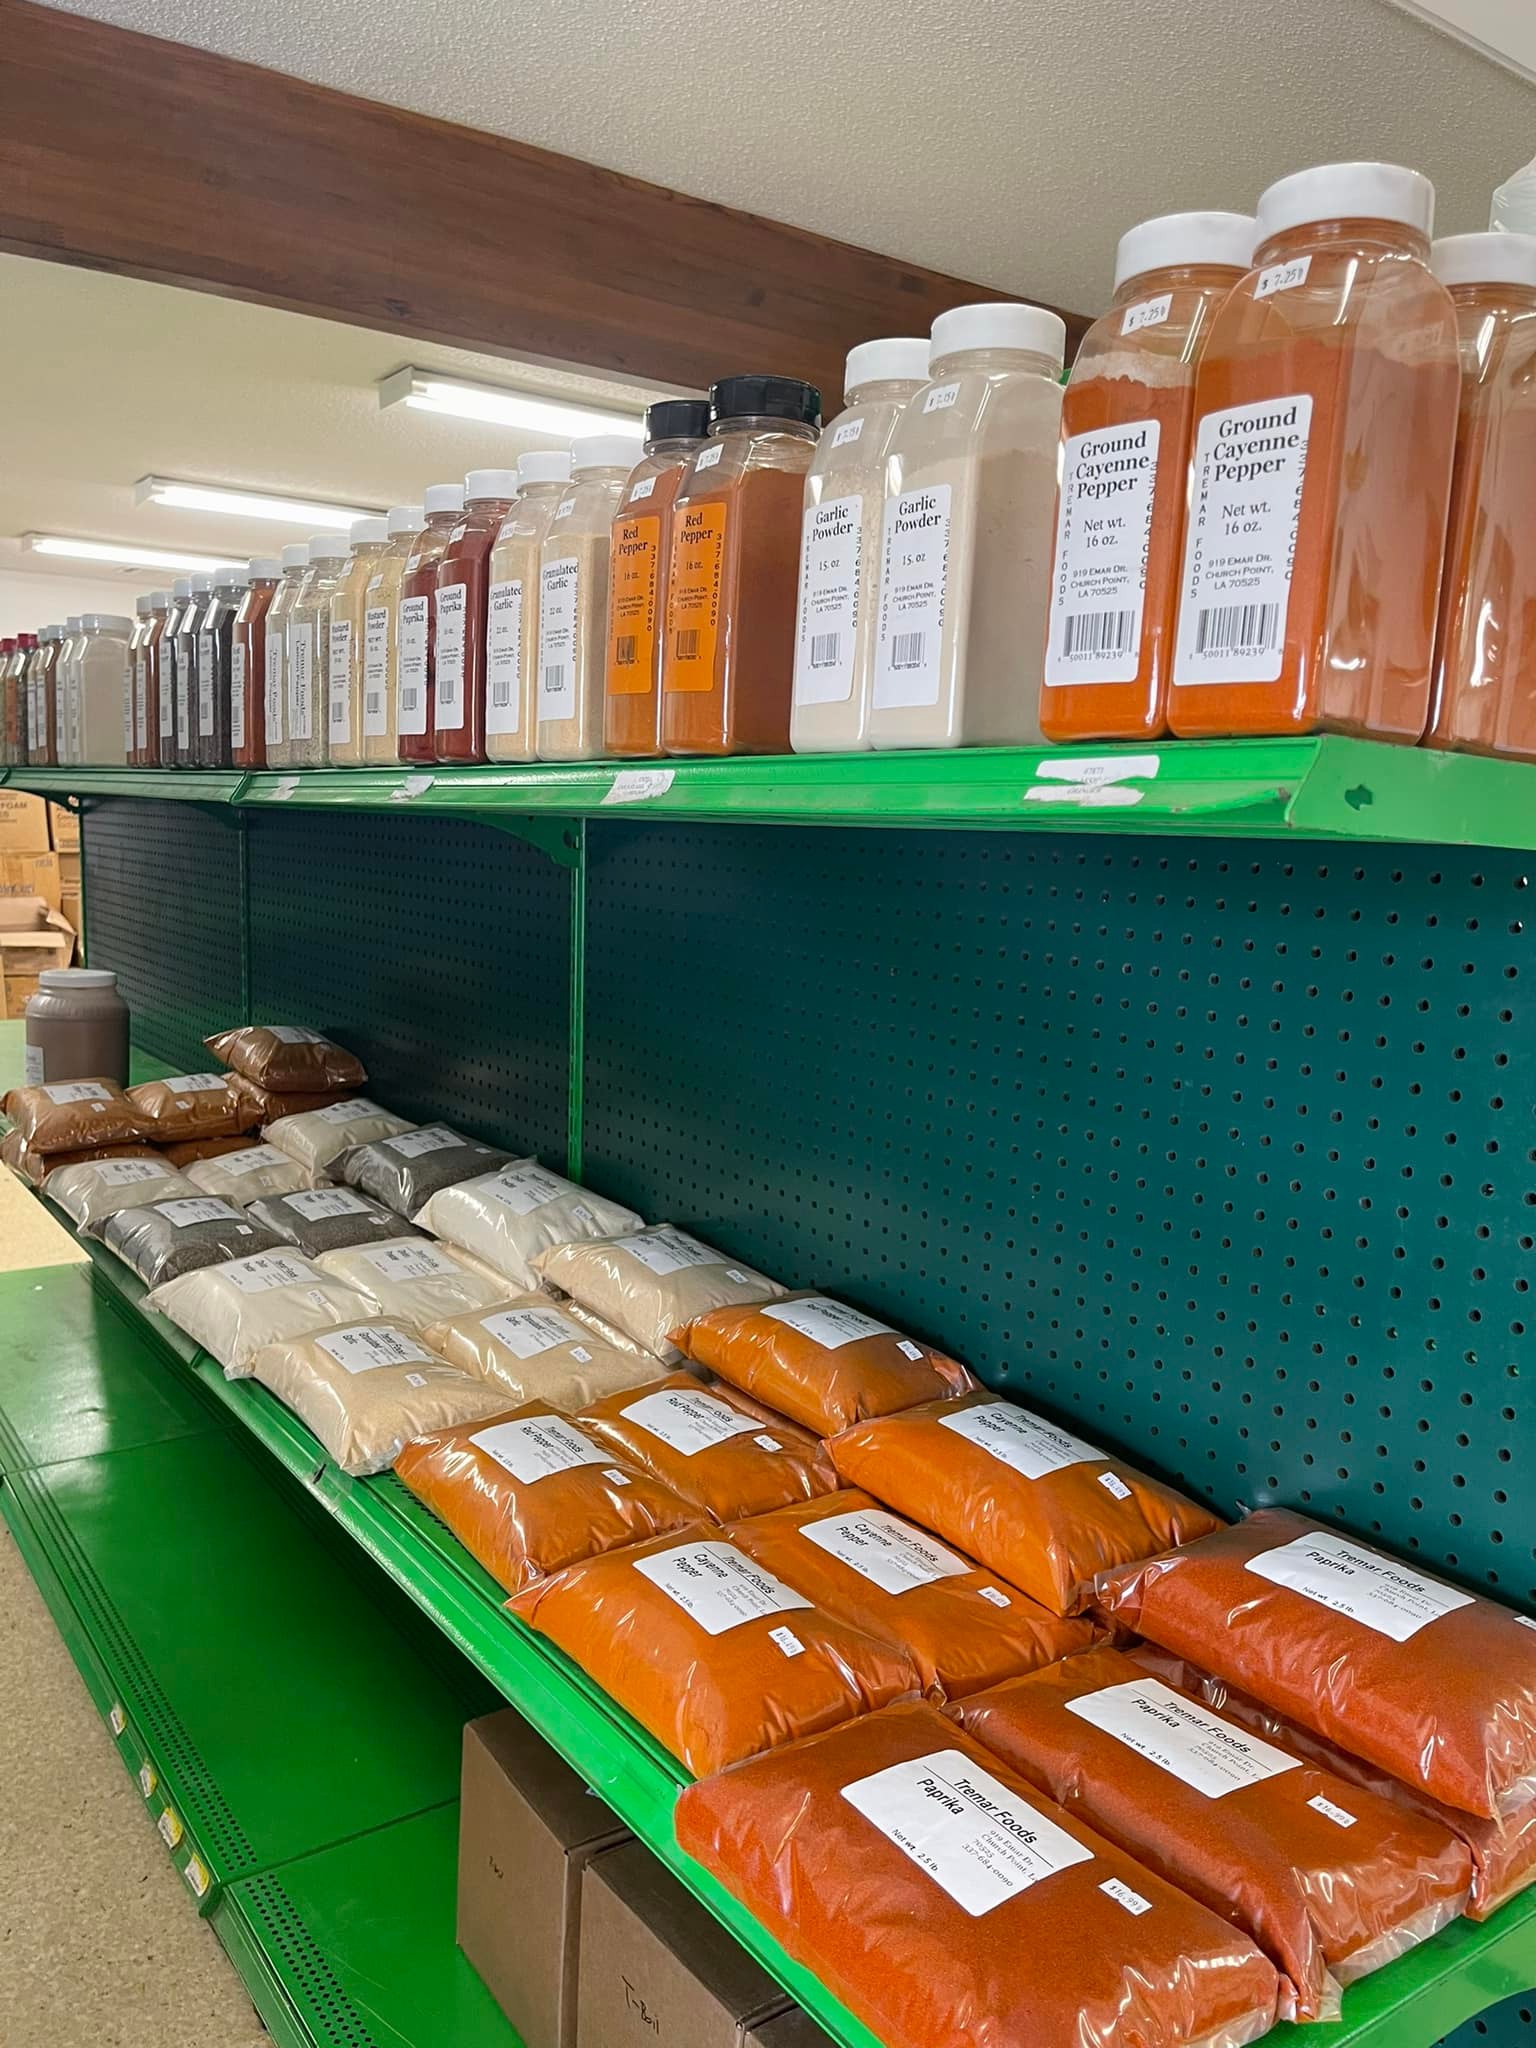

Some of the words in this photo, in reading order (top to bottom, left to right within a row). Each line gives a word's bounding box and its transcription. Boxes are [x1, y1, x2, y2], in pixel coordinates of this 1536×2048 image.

[1219, 406, 1297, 438] Ground
[1080, 430, 1147, 458] Ground
[1213, 433, 1299, 461] Cayenne
[1076, 455, 1150, 480] Cayenne
[1214, 457, 1286, 482] Pepper
[1076, 477, 1138, 499] Pepper
[816, 505, 849, 525] Garlic
[899, 495, 937, 516] Garlic
[1221, 504, 1245, 519] Net
[1250, 501, 1271, 514] wt.
[685, 511, 703, 528] Red
[894, 513, 942, 534] Powder
[1083, 520, 1103, 533] Net
[1107, 517, 1126, 528] wt.
[1225, 521, 1239, 536] 16
[1243, 521, 1262, 533] oz.
[623, 526, 639, 540] Red
[680, 529, 713, 544] Pepper
[812, 521, 854, 542] Powder
[1086, 535, 1098, 549] 16
[1101, 535, 1119, 545] oz.
[618, 542, 648, 557] Pepper
[1073, 569, 1087, 578] 919
[1208, 558, 1226, 568] 919
[547, 577, 569, 591] Garlic
[1078, 590, 1089, 598] LA
[1091, 586, 1118, 596] 70525
[1214, 581, 1226, 590] LA
[1229, 577, 1261, 589] 70525
[494, 598, 513, 611] Garlic
[666, 1396, 681, 1408] Red
[678, 1403, 705, 1420] Pepper
[973, 1415, 1006, 1433] Pepper
[990, 1412, 1028, 1435] Cayenne
[836, 1525, 869, 1548] Pepper
[854, 1522, 892, 1548] Cayenne
[879, 1524, 913, 1545] Tremar
[909, 1541, 939, 1563] Foods
[672, 1556, 703, 1578] Pepper
[693, 1553, 728, 1579] Cayenne
[1305, 1550, 1355, 1577] Paprika
[1337, 1549, 1382, 1576] Tremar
[1381, 1570, 1426, 1594] Foods
[722, 1555, 751, 1578] Tremar
[747, 1573, 775, 1595] Foods
[1302, 1585, 1317, 1598] Net
[1131, 1698, 1180, 1729] Paprika
[1164, 1701, 1210, 1729] Tremar
[1207, 1726, 1251, 1754] Foods
[1120, 1732, 1136, 1744] Net
[1149, 1751, 1164, 1762] 2.5
[916, 1778, 965, 1815] Paprika
[953, 1778, 999, 1813] Tremar
[994, 1810, 1038, 1844] Foods
[892, 1829, 905, 1843] Net
[904, 1840, 917, 1853] wt.
[917, 1852, 930, 1865] 2.5
[973, 1839, 994, 1858] 70525
[981, 1834, 1008, 1860] Church
[990, 1830, 1004, 1842] 919
[1003, 1840, 1025, 1858] Emar
[962, 1845, 1013, 1887] 337-684-0090
